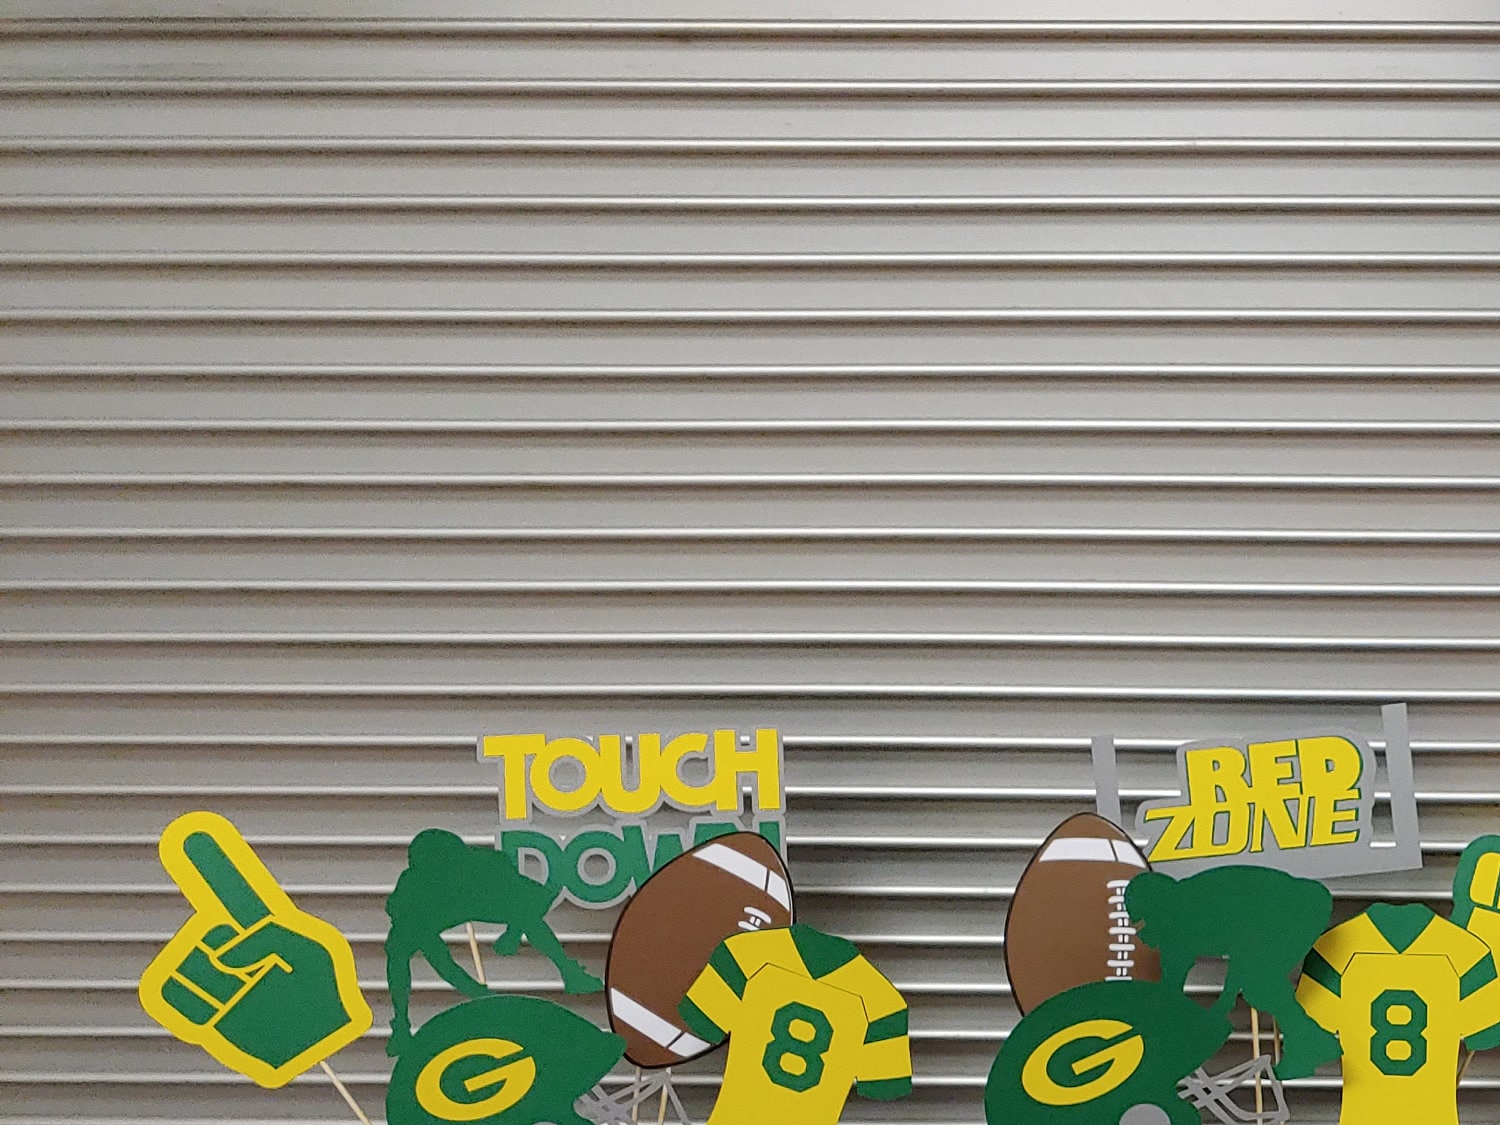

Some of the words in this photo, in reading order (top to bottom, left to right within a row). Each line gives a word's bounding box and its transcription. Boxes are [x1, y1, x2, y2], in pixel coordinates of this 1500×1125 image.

[484, 729, 780, 820] TOUCH
[1186, 736, 1364, 801] RED
[501, 820, 781, 904] DOW
[1144, 795, 1360, 863] ZONE
[763, 1003, 834, 1091] 8
[1021, 1019, 1144, 1106] G
[1371, 990, 1427, 1076] 8
[415, 1038, 536, 1121] G
